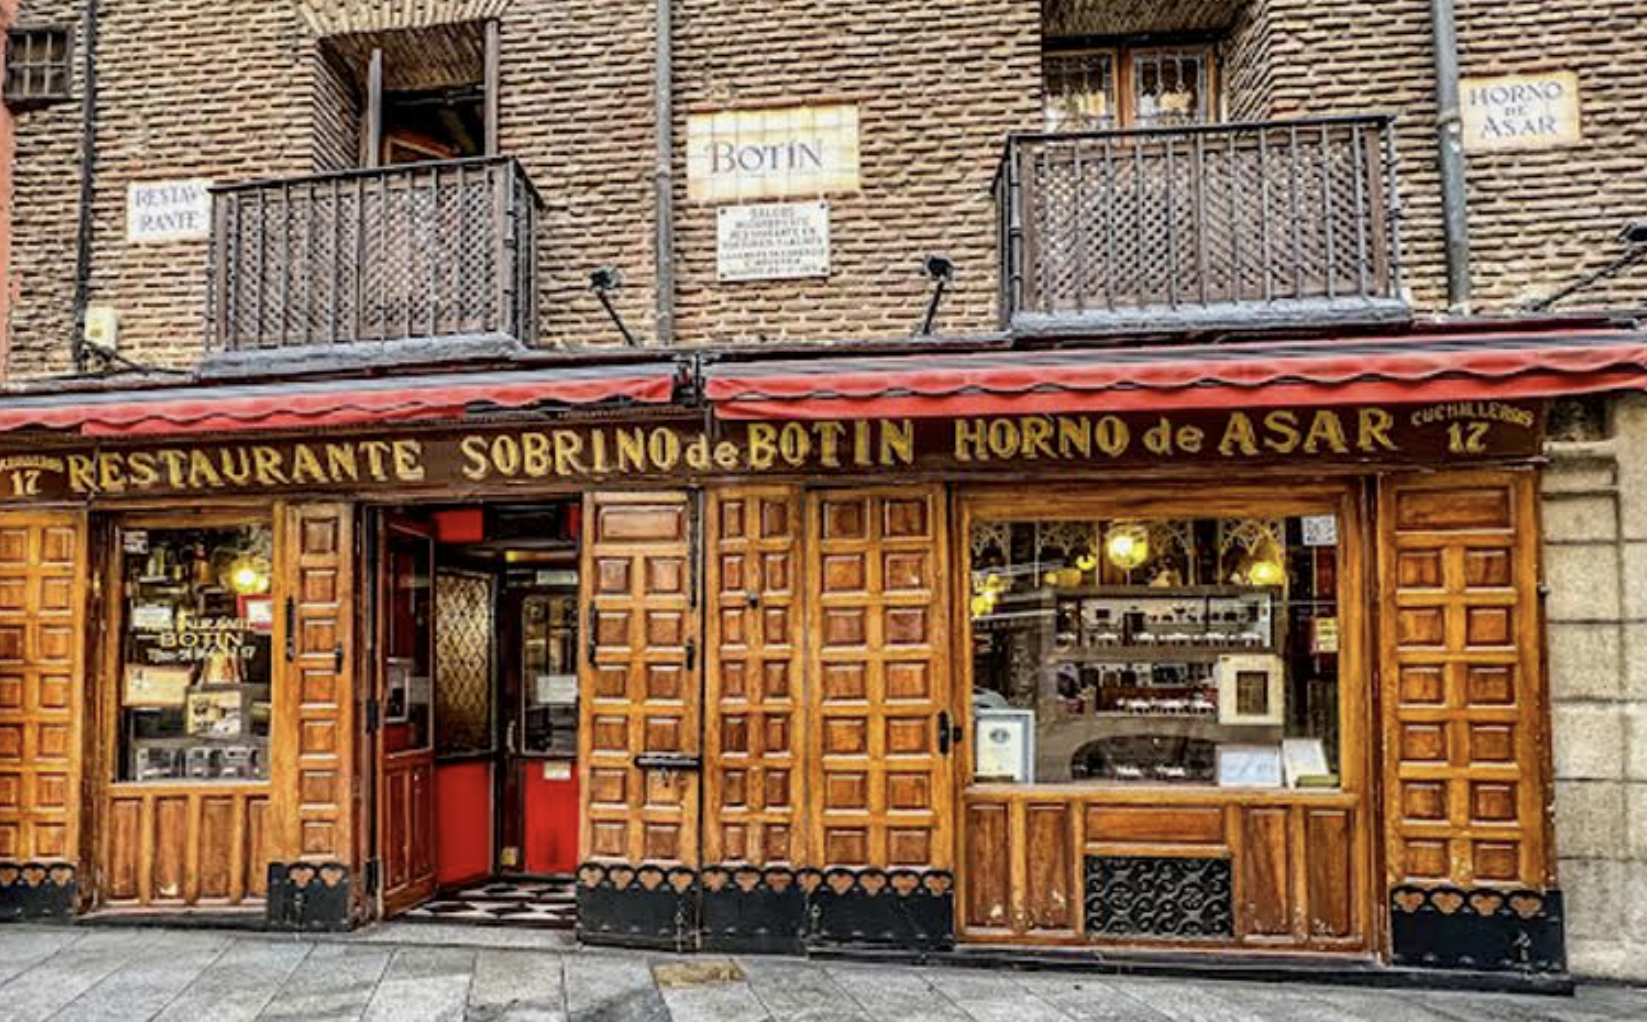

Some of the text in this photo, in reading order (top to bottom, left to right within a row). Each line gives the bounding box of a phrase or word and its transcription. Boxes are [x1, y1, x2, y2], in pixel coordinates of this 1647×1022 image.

[1469, 82, 1562, 106] HORNO
[1480, 116, 1557, 139] ASAR
[140, 210, 200, 232] RANTE
[1447, 421, 1489, 453] 17
[67, 439, 424, 493] RESTAURANTE
[461, 427, 680, 480] SOBRINO
[685, 440, 739, 467] de
[746, 418, 915, 470] BOTIN
[954, 415, 1130, 462] HORNO
[1143, 416, 1204, 455] de
[1217, 408, 1398, 457] ASAR
[11, 469, 41, 496] 17
[160, 632, 243, 648] BOTIN
